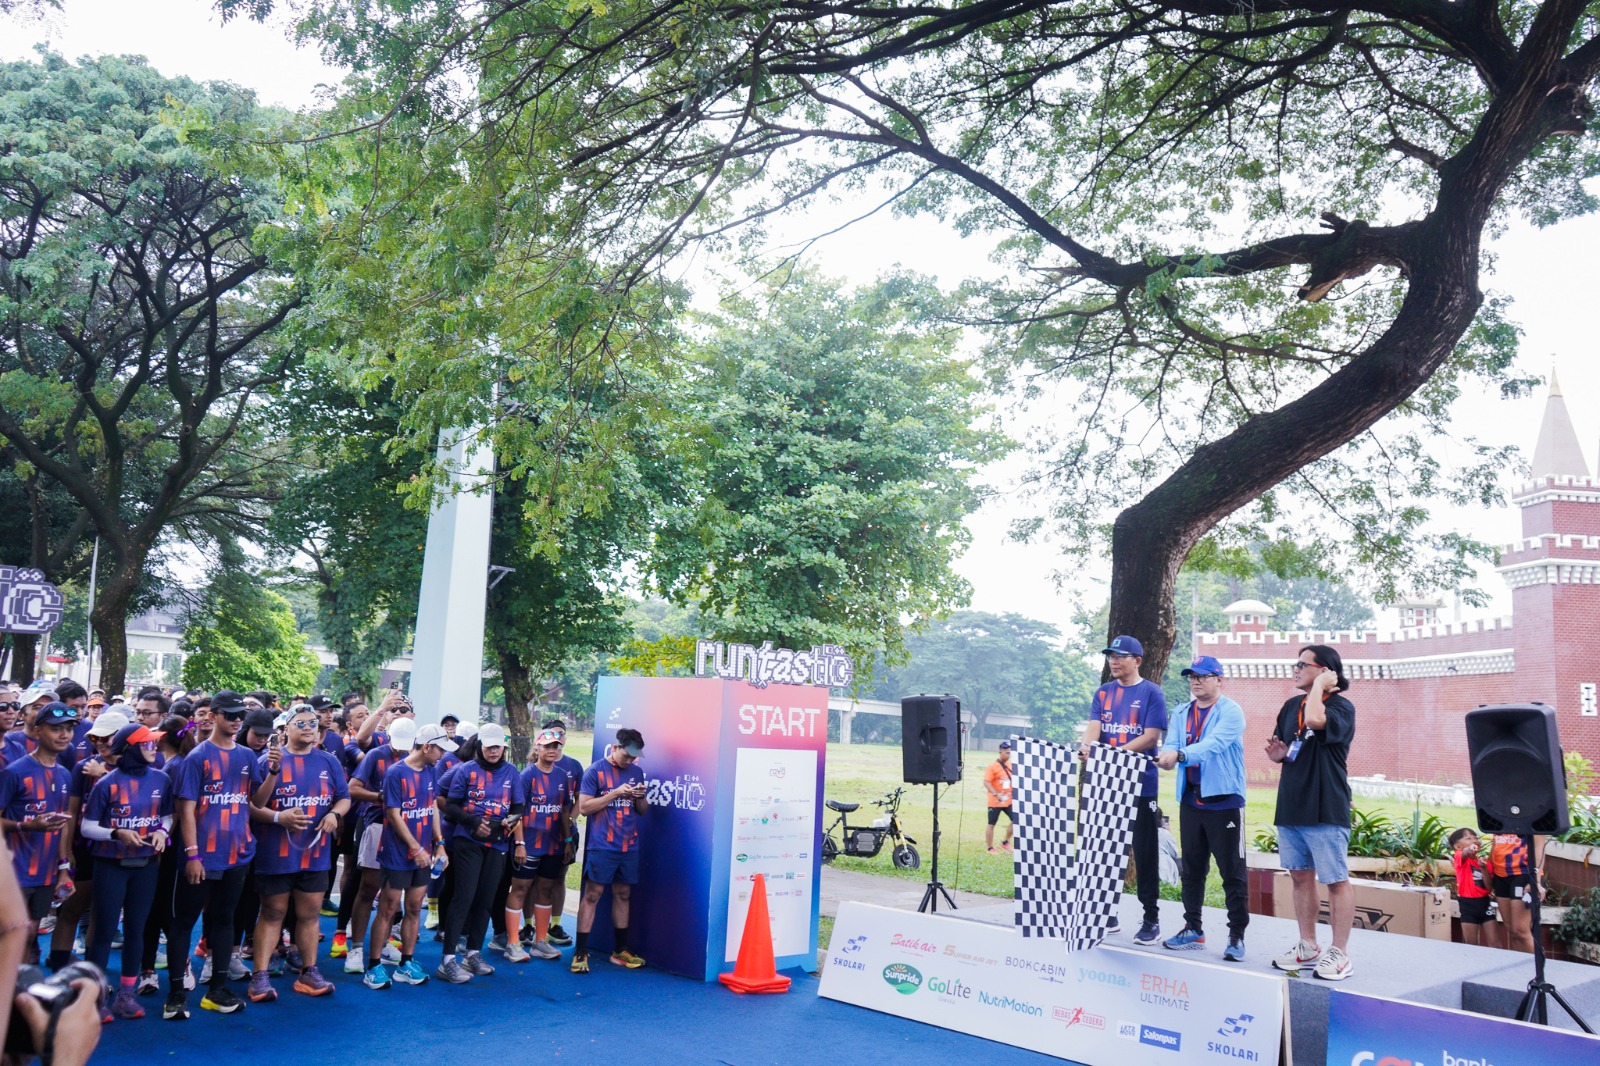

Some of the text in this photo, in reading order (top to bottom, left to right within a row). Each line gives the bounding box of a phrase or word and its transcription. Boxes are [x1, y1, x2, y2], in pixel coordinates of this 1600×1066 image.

[696, 640, 852, 688] runtastic
[738, 704, 821, 737] START
[1102, 722, 1143, 735] untastic
[276, 794, 332, 808] runtastic
[891, 933, 937, 953] Batik air
[833, 957, 865, 971] SKOLARI
[1005, 956, 1066, 977] BOOKCABIN
[885, 969, 920, 985] Sunpride
[1140, 973, 1190, 998] ERHA
[927, 976, 972, 999] GoLite
[978, 990, 1043, 1017] NutriMotion
[1140, 992, 1190, 1011] ULTIMATE
[1054, 1008, 1071, 1020] BEBAS
[1082, 1014, 1103, 1027] CEDERA
[1142, 1029, 1178, 1045] Salonpas
[1207, 1041, 1259, 1062] SKOLARI
